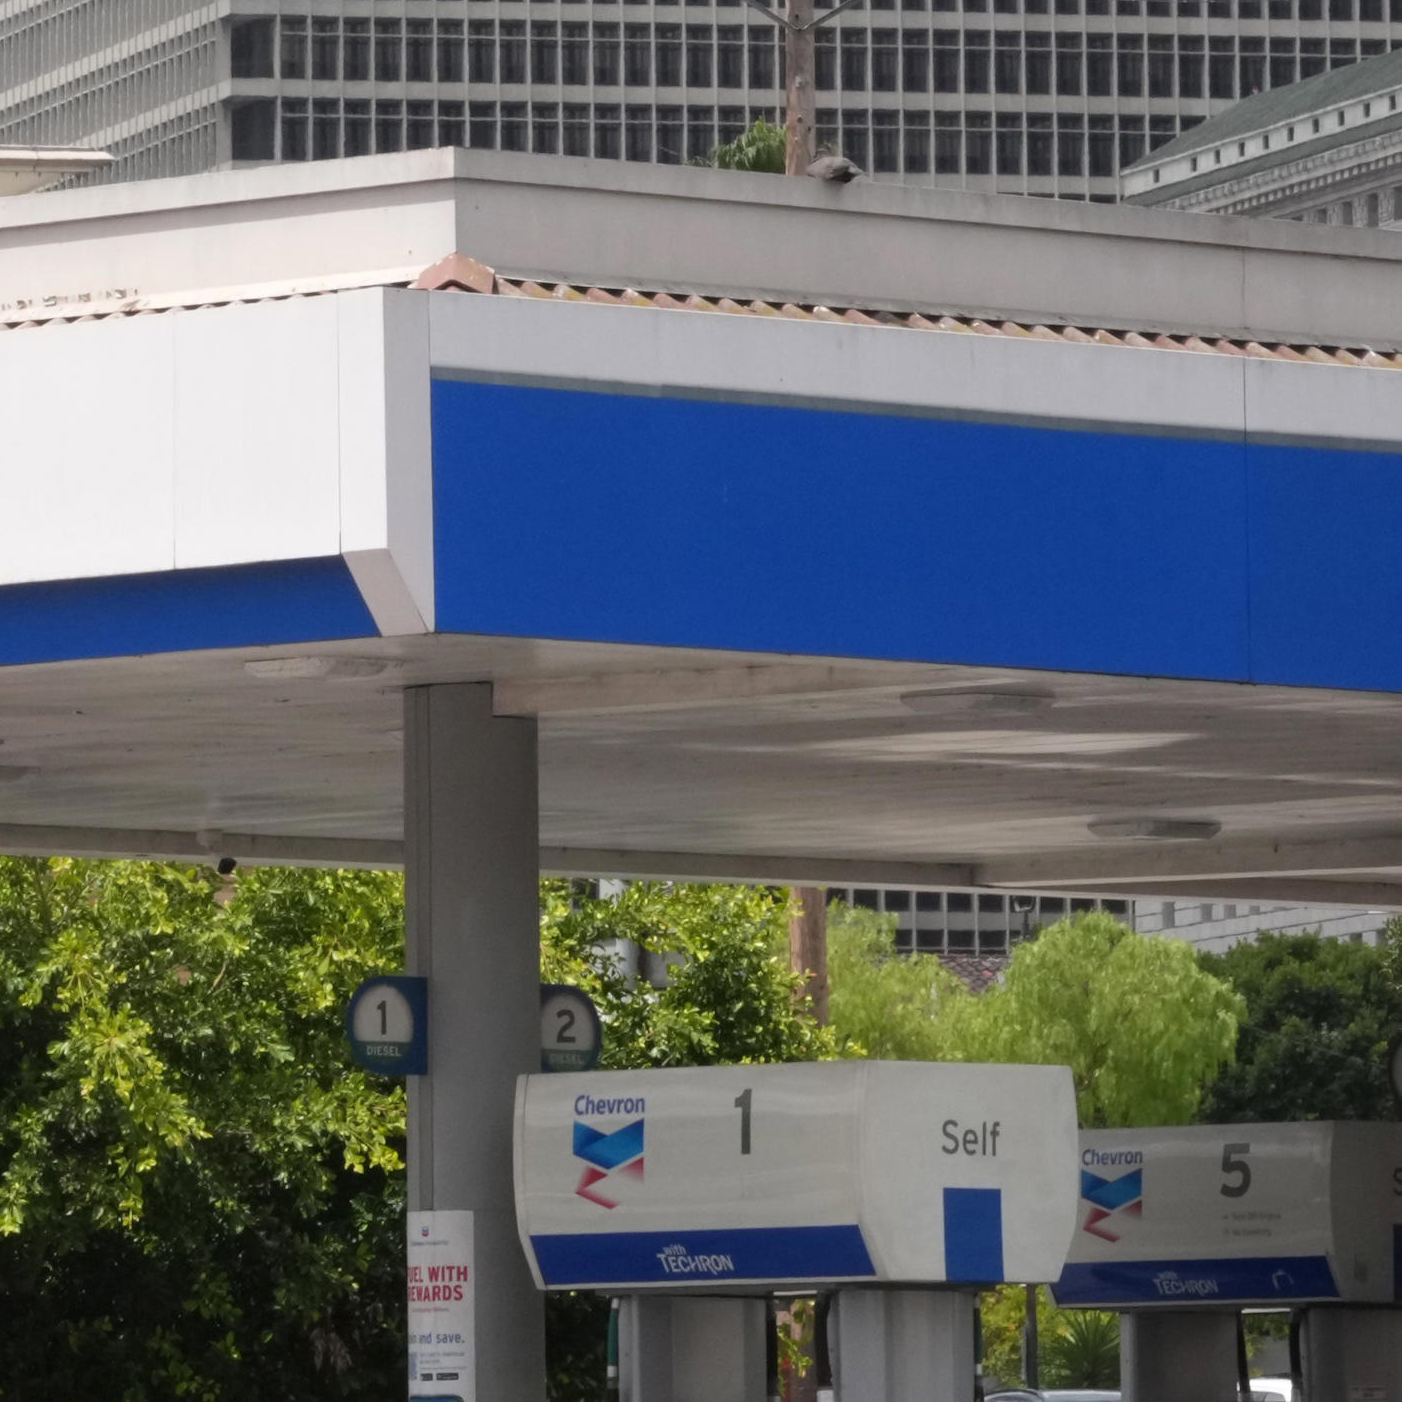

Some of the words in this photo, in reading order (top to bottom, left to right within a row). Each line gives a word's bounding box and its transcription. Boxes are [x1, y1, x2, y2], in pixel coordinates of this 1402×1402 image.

[376, 1000, 387, 1036] 1
[555, 1009, 576, 1044] 2
[366, 1044, 402, 1057] DIESEL
[574, 1094, 645, 1116] Chevron
[734, 1088, 752, 1156] 1
[940, 1119, 1001, 1157] Self
[1082, 1149, 1144, 1166] Chevron
[1219, 1143, 1252, 1199] 5
[427, 1265, 468, 1283] WITH
[656, 1253, 734, 1275] TECHRON
[436, 1333, 465, 1344] save.
